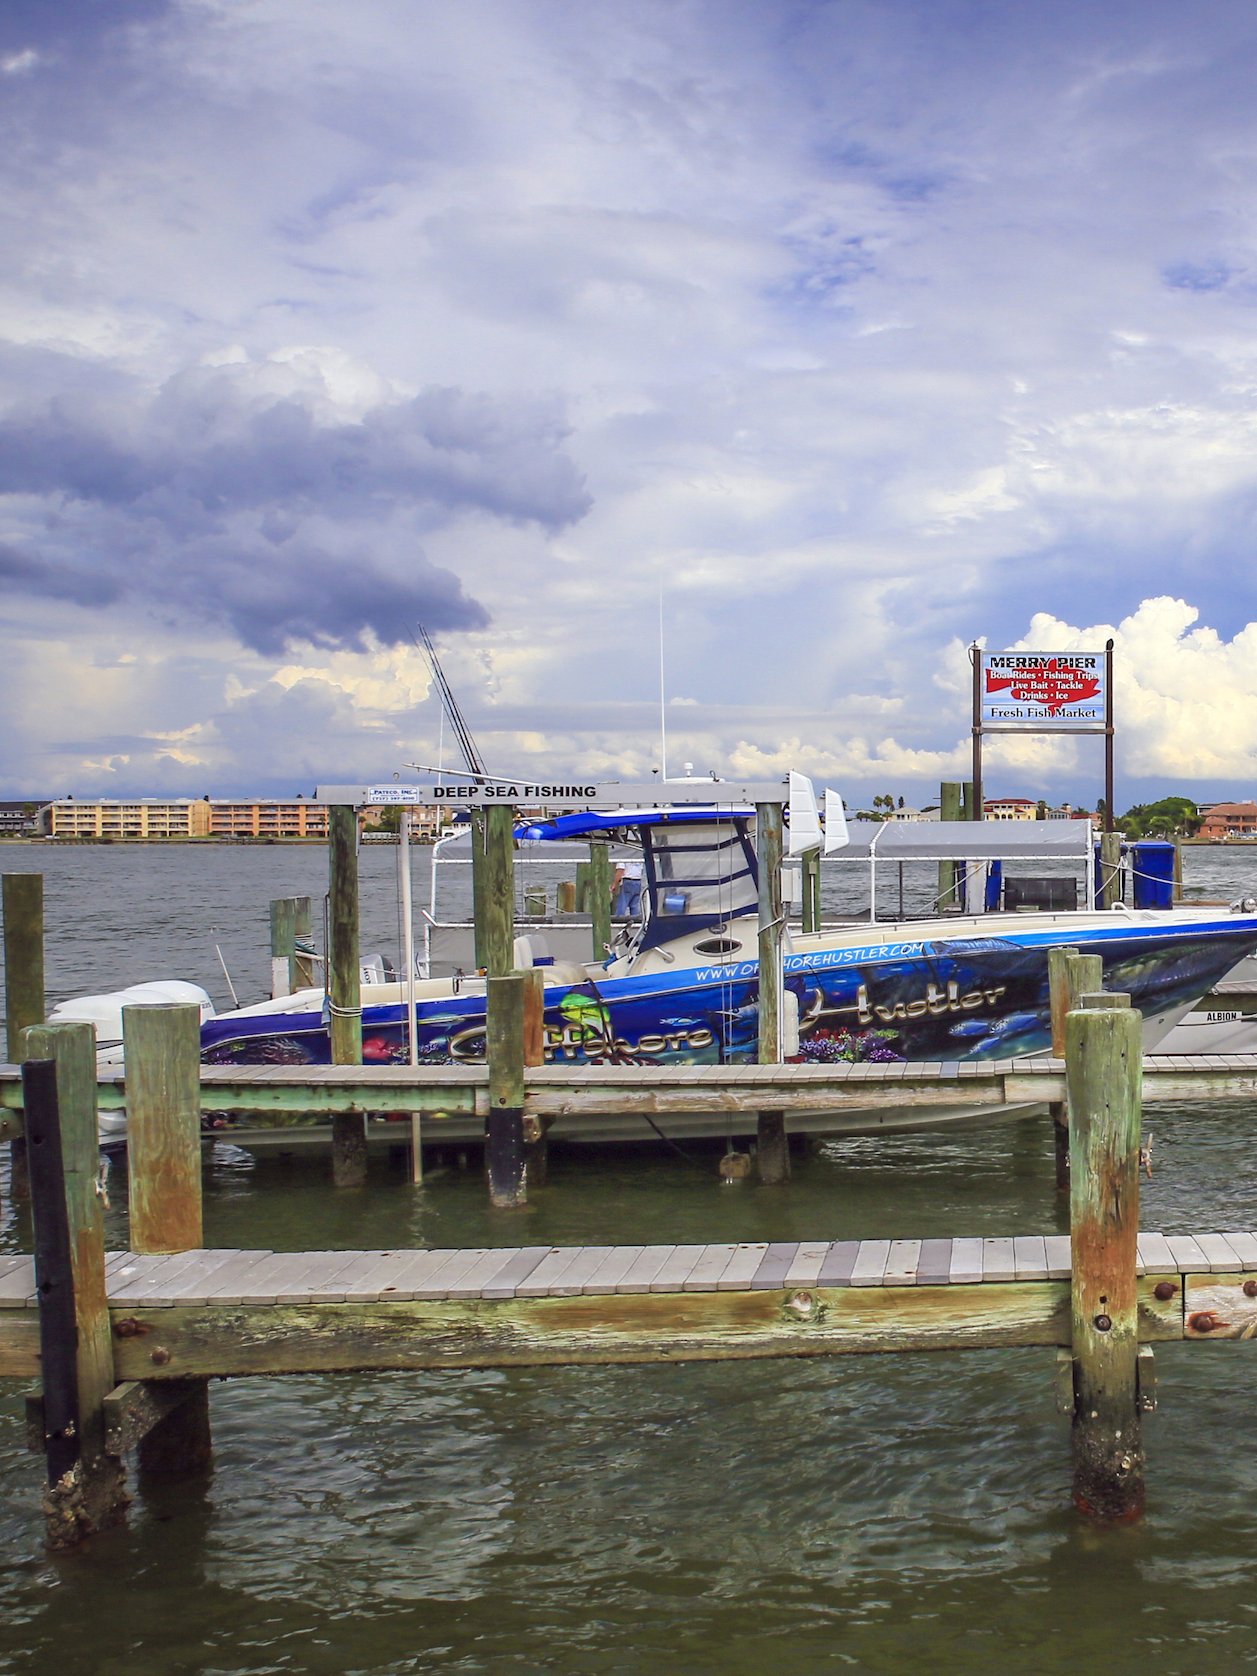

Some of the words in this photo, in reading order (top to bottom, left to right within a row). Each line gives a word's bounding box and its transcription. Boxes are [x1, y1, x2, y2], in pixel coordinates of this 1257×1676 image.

[990, 657, 1051, 668] MERRY
[1057, 657, 1096, 668] PIER
[990, 670, 1009, 679] Boat
[1012, 671, 1036, 679] Rides
[1043, 671, 1074, 681] Fishing
[1077, 671, 1099, 680] Trips
[1011, 681, 1028, 689] Live
[1030, 681, 1048, 689] Bait
[1055, 681, 1083, 689] Tackle
[1020, 691, 1048, 699] Drinks
[1056, 691, 1068, 699] Ice
[991, 708, 1023, 718] Fresh
[1027, 708, 1051, 718] Fish
[1055, 708, 1096, 718] Market
[433, 786, 479, 798] DEEP
[484, 786, 519, 798] SEA
[525, 786, 597, 798] FISHING
[798, 981, 1006, 1031] Hustler
[1207, 1012, 1237, 1021] ALBION
